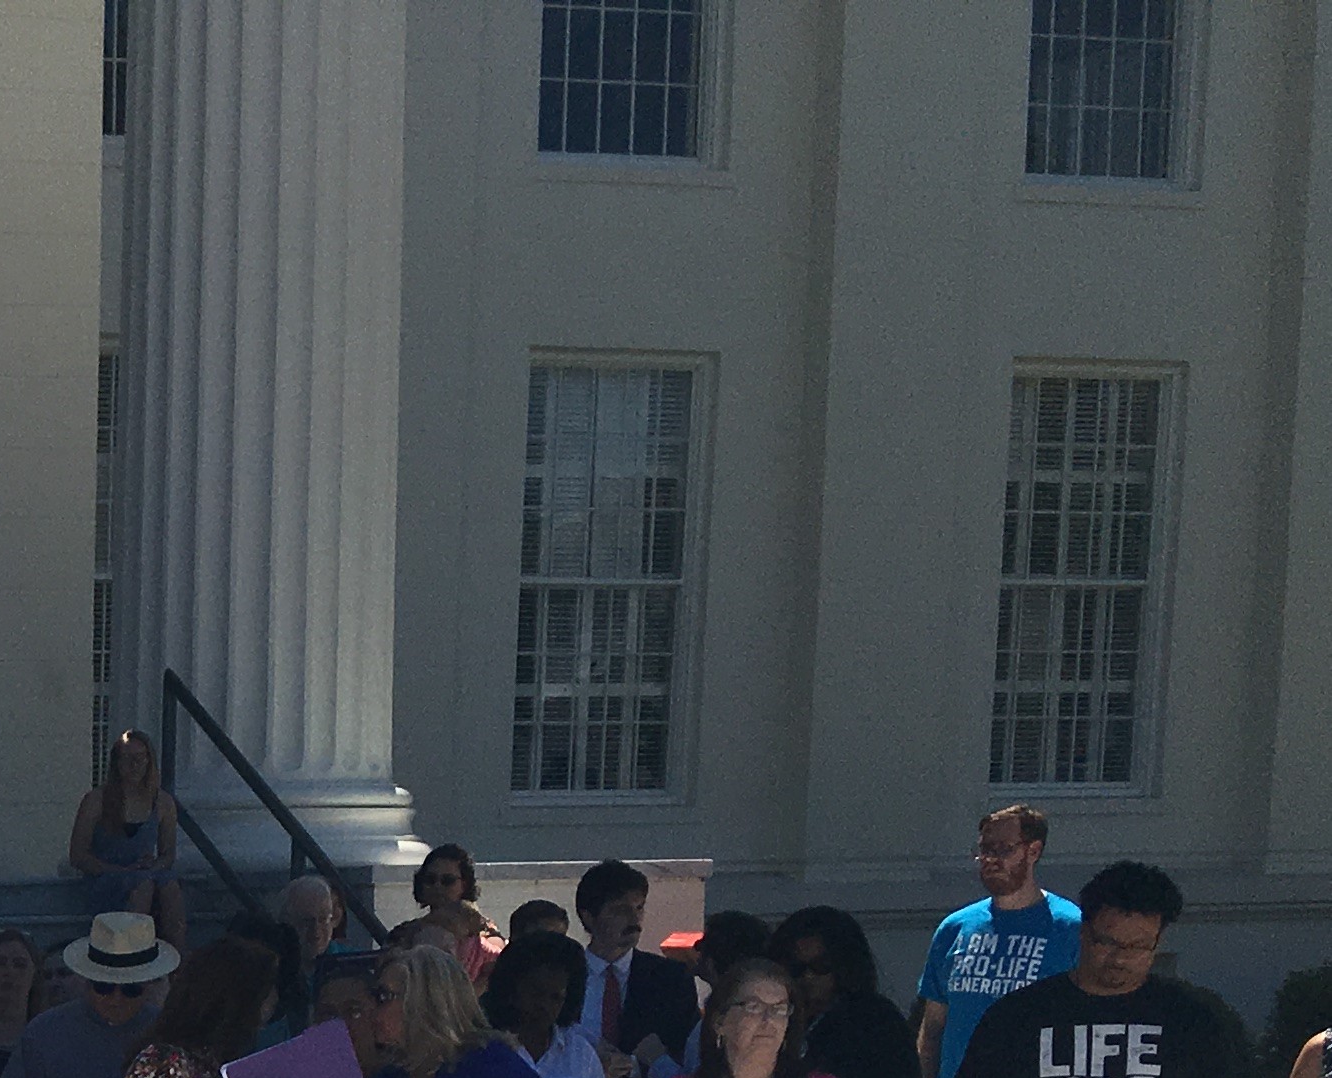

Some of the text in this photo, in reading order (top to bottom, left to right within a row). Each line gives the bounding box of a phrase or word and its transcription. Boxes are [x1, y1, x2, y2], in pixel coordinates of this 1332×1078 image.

[967, 933, 999, 955] AM
[1006, 934, 1049, 959] THE
[950, 955, 1042, 981] PRO-LIFE
[948, 977, 1033, 996] GENERATIO
[1039, 1023, 1163, 1078] LIFE
